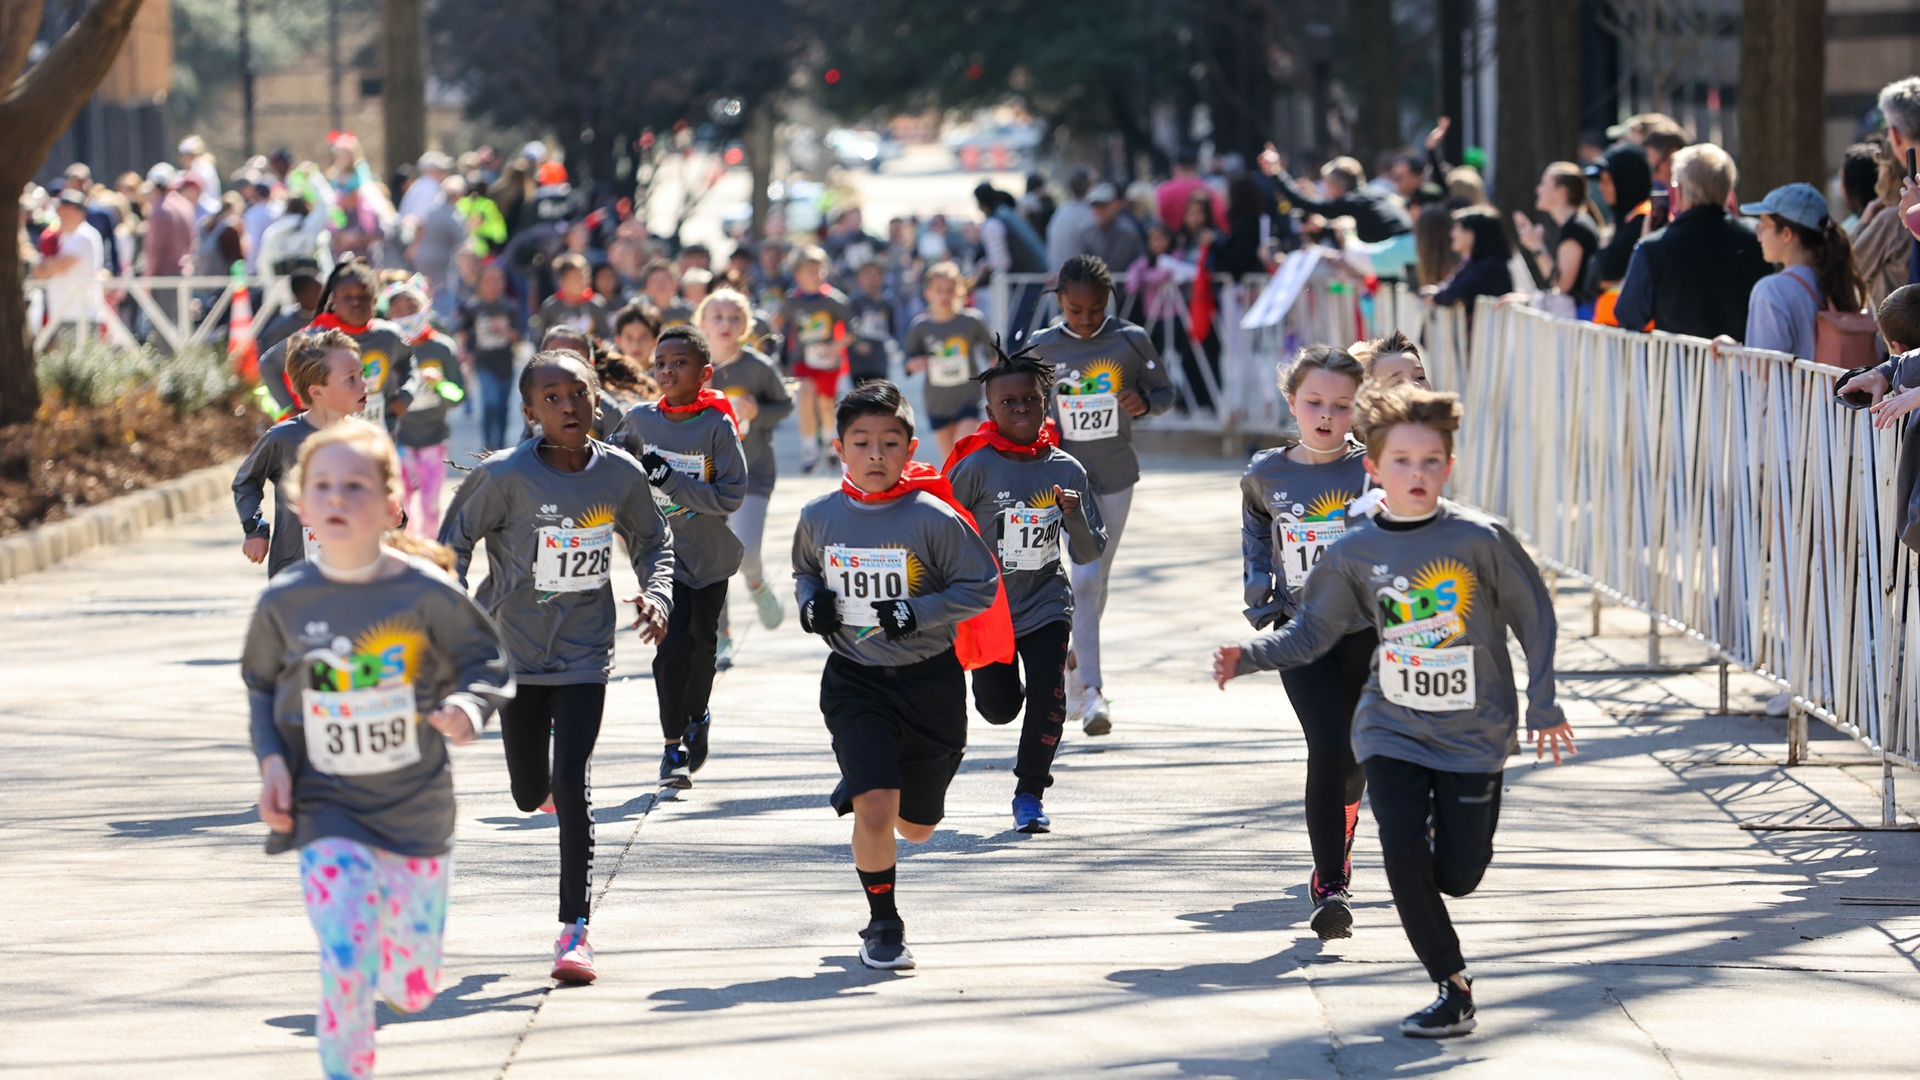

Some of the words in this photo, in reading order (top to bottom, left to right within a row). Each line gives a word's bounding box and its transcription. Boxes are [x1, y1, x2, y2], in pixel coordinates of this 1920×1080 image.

[1070, 409, 1113, 430] 1237
[1020, 519, 1058, 548] 1240
[557, 546, 610, 577] 1226
[840, 571, 902, 598] 1910
[1398, 669, 1467, 697] 1903
[326, 718, 405, 754] 3159
